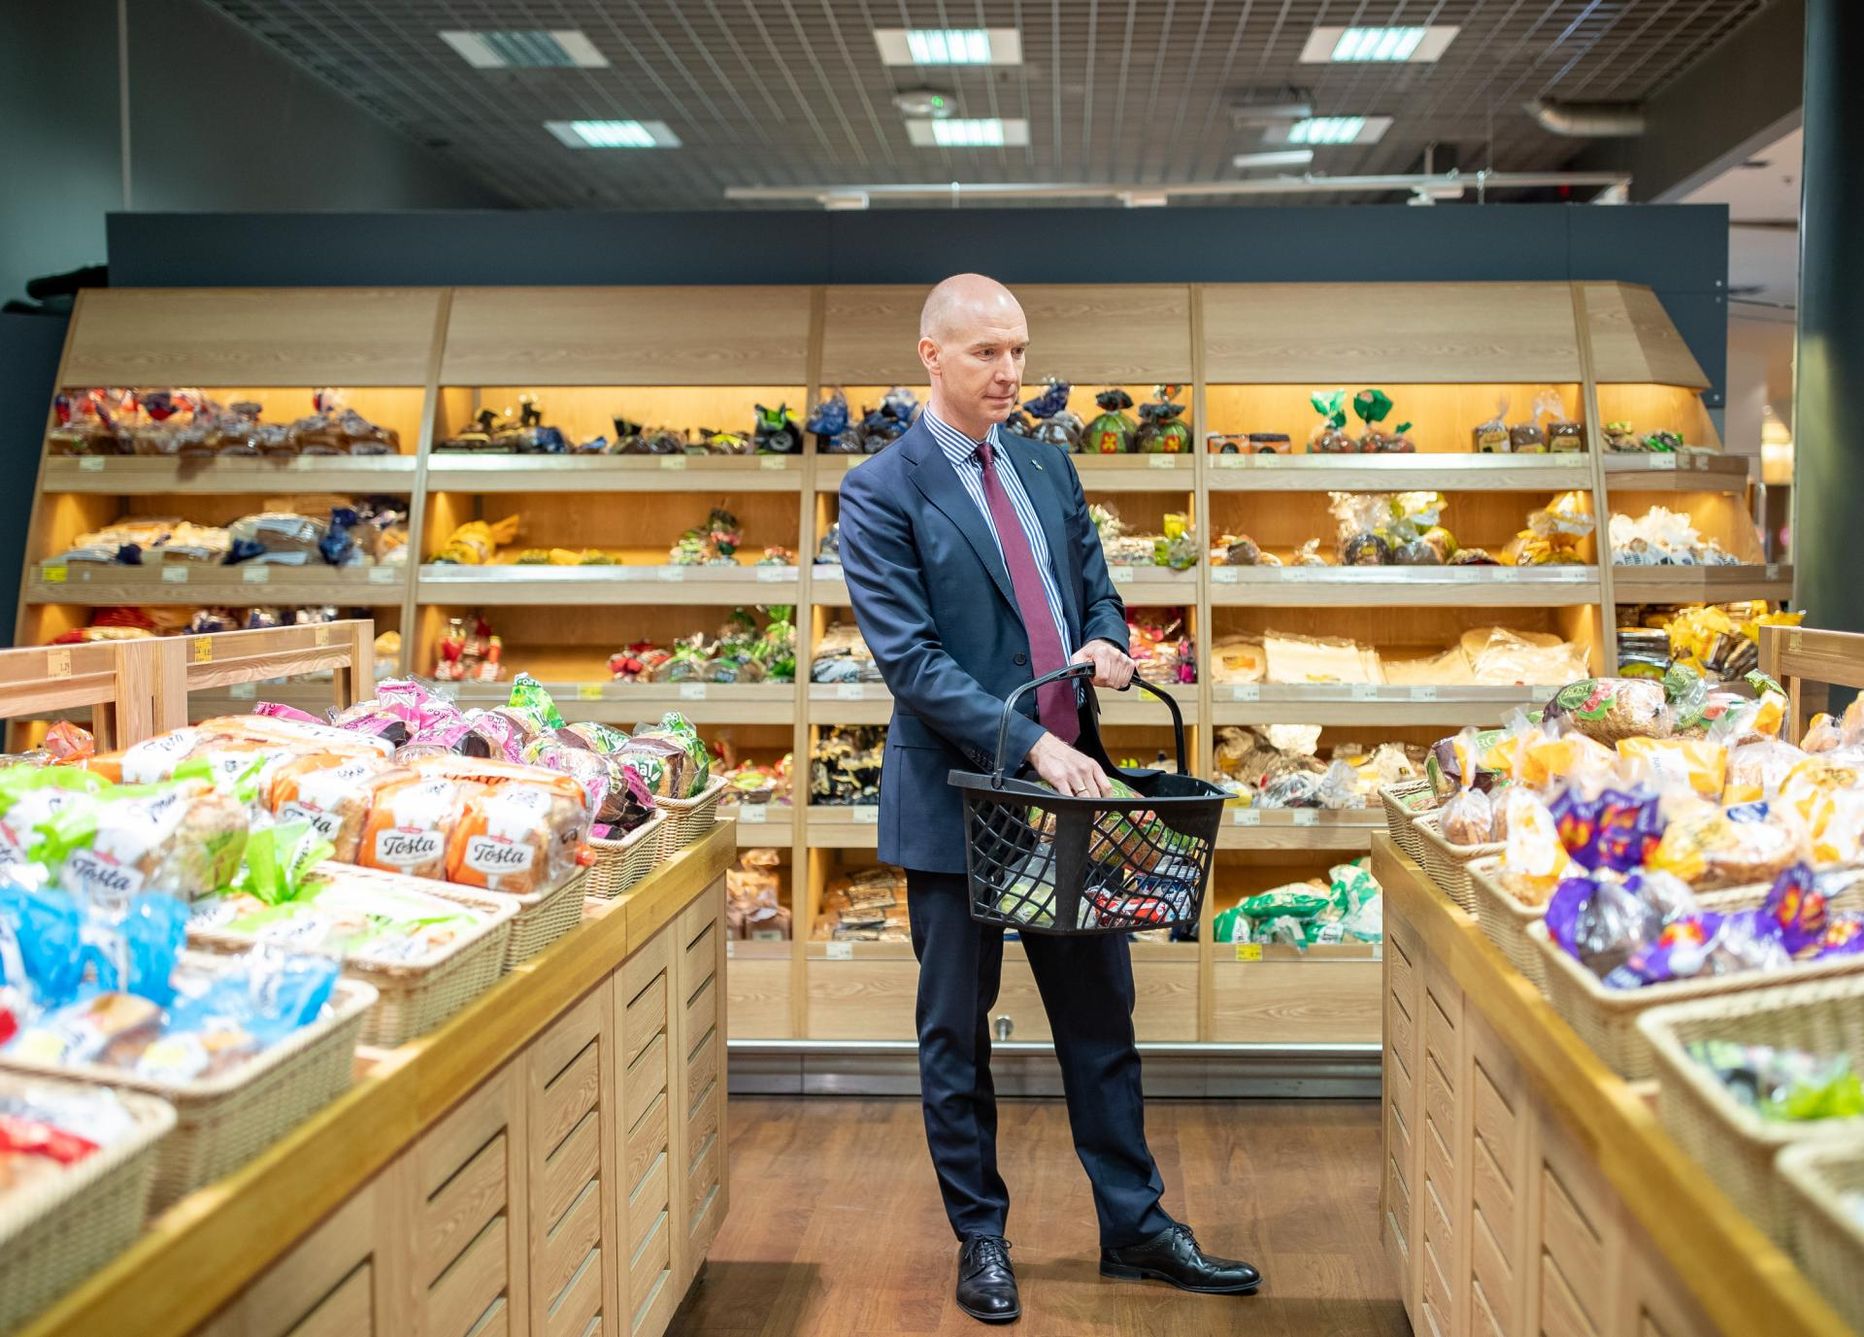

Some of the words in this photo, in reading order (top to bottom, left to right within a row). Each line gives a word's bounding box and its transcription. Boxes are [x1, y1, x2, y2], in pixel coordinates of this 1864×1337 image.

[383, 836, 437, 856] Tosta
[474, 843, 526, 865] Tosta
[72, 858, 131, 891] Tosta
